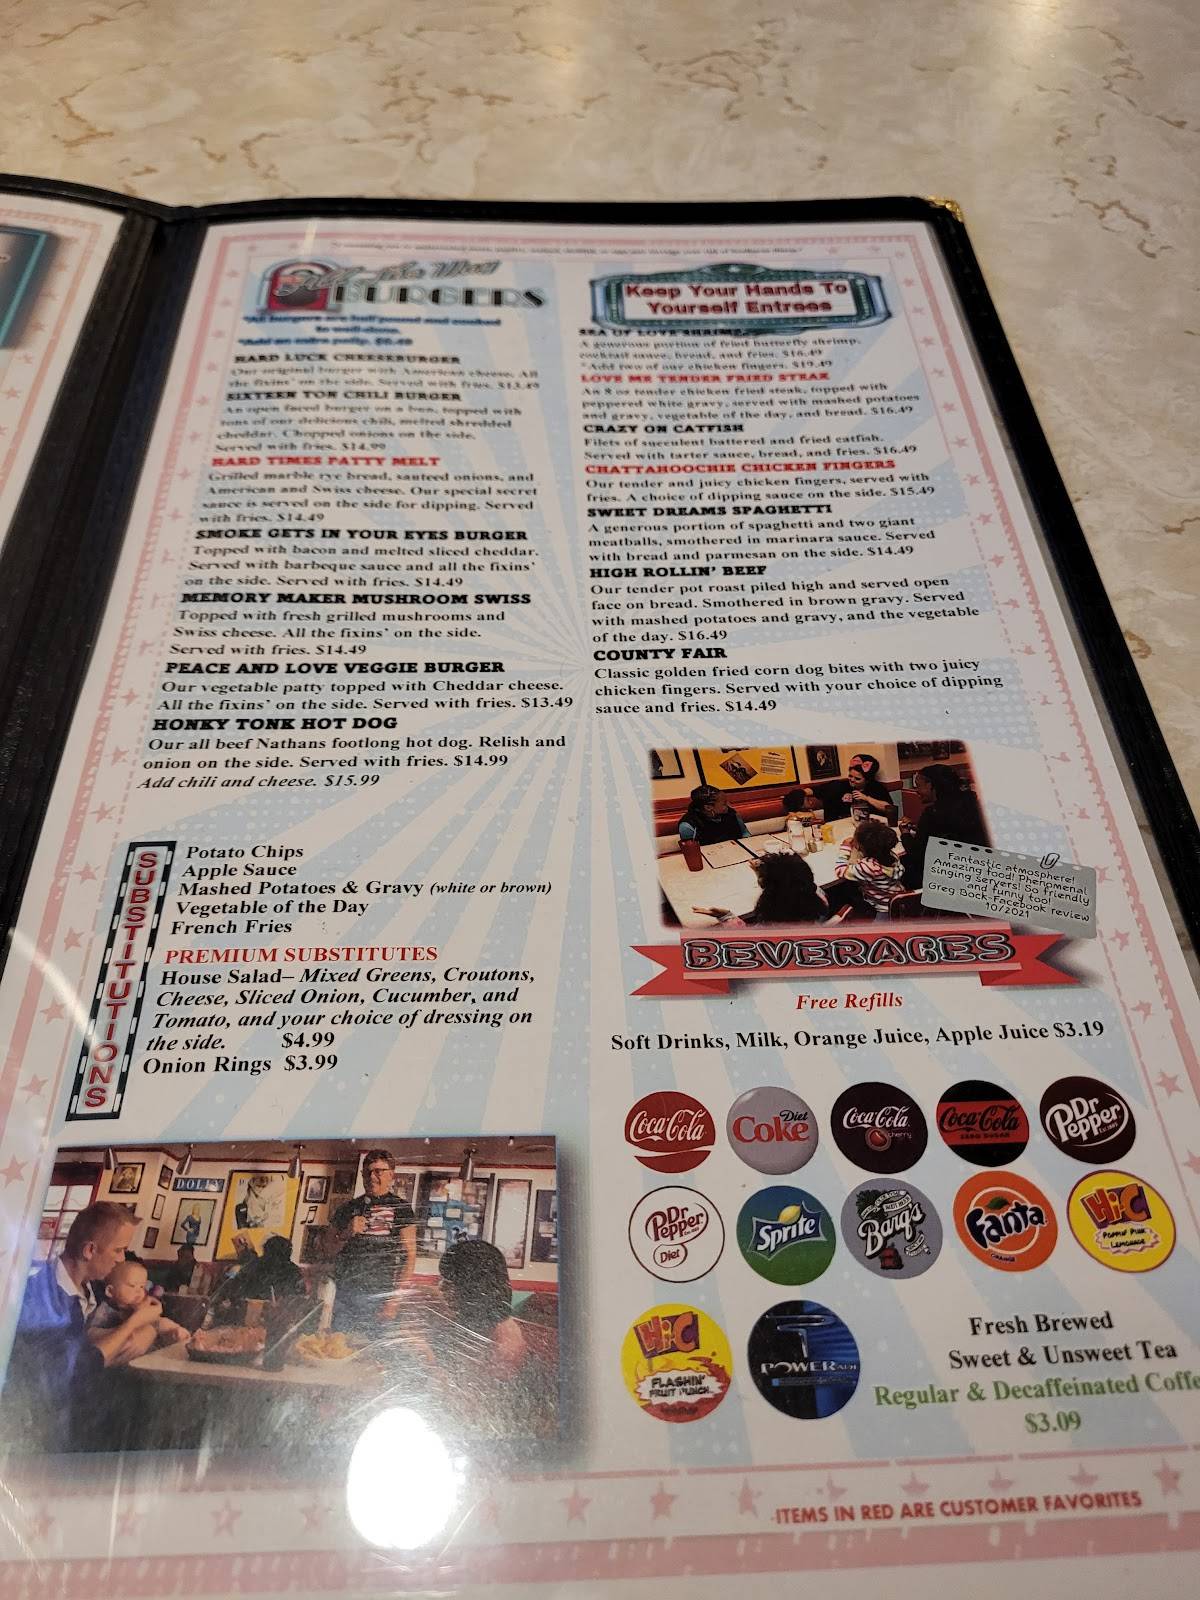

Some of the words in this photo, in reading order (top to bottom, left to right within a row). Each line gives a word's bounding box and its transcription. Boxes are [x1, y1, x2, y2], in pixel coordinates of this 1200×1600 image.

[626, 285, 680, 299] Keep
[689, 284, 738, 297] Your
[745, 282, 814, 296] Hands
[820, 282, 847, 294] To
[647, 301, 739, 315] Yourself
[745, 300, 832, 313] Entrees
[583, 424, 638, 433] CRAZY
[643, 425, 667, 433] ON
[672, 424, 744, 433] CATFISH
[584, 463, 736, 474] CHATTAHOOCHIE
[740, 462, 817, 472] CHICKEN
[822, 459, 896, 471] FINGERS
[587, 507, 647, 517] SWEET
[652, 506, 727, 517] DREAMS
[731, 504, 832, 515] SPAGHETTI
[195, 528, 262, 540] SMOKE
[267, 528, 315, 539] GETS
[321, 528, 341, 538] IN
[346, 529, 398, 540] YOUR
[403, 530, 448, 540] EYES
[454, 530, 528, 540] BURGER
[589, 567, 637, 578] HIGH
[642, 566, 716, 577] ROLLIN'
[721, 565, 767, 576] BEEF
[180, 592, 271, 603] MEMORY
[276, 592, 346, 604] MAKER
[351, 593, 468, 605] MUSHROOM
[473, 593, 531, 604] SWISS
[593, 648, 676, 661] COUNTY
[680, 647, 727, 659] FAIR
[164, 662, 231, 674] PEACE
[234, 663, 279, 674] AND
[284, 662, 338, 674] LOVE
[343, 662, 418, 674] VEGGIE
[423, 661, 505, 673] BURGER
[595, 705, 640, 714] sauce
[644, 701, 674, 713] and
[680, 701, 720, 712] fries.
[725, 699, 777, 712] $14.49
[152, 718, 230, 731] HONKY
[235, 718, 295, 730] TONK
[300, 717, 347, 730] HOT
[351, 716, 398, 729] DOG
[136, 776, 176, 788] Add
[177, 776, 218, 788] chili
[220, 775, 256, 787] and
[257, 775, 317, 787] cheese.
[323, 774, 380, 787] $15.99
[185, 846, 245, 859] Potato
[251, 845, 303, 861] Chips
[181, 863, 238, 880] Apple
[242, 863, 297, 876] Sauce
[933, 858, 982, 875] Amazing
[987, 867, 1014, 880] food!
[1019, 874, 1087, 895] Phenomenal
[948, 852, 1001, 869] Fantastic
[1005, 864, 1075, 884] atmosphere!
[178, 881, 252, 896] Mashed
[257, 881, 336, 895] Potatoes
[341, 880, 358, 894] &
[365, 880, 424, 897] Gravy
[429, 882, 476, 895] (white
[479, 884, 496, 893] or
[500, 881, 551, 895] brown)
[930, 866, 971, 882] singing
[976, 876, 1020, 890] servers!
[1025, 885, 1038, 894] So
[1044, 887, 1089, 907] friendly
[967, 883, 988, 892] and
[992, 887, 1024, 902] funny
[176, 900, 268, 918] Vegetable
[273, 899, 295, 913] of
[298, 899, 327, 913] the
[332, 899, 369, 916] Day
[928, 882, 955, 896] Greg
[1051, 908, 1090, 921] review
[985, 902, 1030, 918] 10/2021
[171, 920, 237, 935] French
[244, 919, 292, 933] Fries
[164, 948, 279, 964] PREMIUM
[283, 946, 438, 962] SUBSTITUTES
[683, 934, 1015, 970] BEVERAGES
[83, 851, 158, 1109] SUBSTITUTIONS
[159, 970, 222, 985] House
[298, 967, 361, 983] Mixed
[366, 967, 436, 984] Greens,
[443, 967, 534, 983] Croutons,
[156, 991, 228, 1007] Cheese,
[234, 989, 296, 1004] Sliced
[300, 988, 365, 1005] Onion,
[372, 987, 476, 1005] Cucumber,
[482, 986, 519, 1002] and
[796, 995, 838, 1010] Free
[844, 992, 903, 1012] Refills
[152, 1013, 231, 1029] Tomato,
[237, 1010, 277, 1026] and
[276, 1014, 326, 1030] your
[330, 1009, 393, 1025] choice
[398, 1009, 422, 1029] of
[423, 1008, 504, 1027] dressing
[508, 1012, 532, 1024] on
[145, 1035, 178, 1051] the
[181, 1033, 225, 1050] side.
[281, 1031, 335, 1048] $4.99
[611, 1034, 650, 1050] Soft
[657, 1033, 730, 1051] Drinks,
[735, 1031, 788, 1049] Milk,
[793, 1030, 867, 1049] Orange
[873, 1028, 930, 1045] Juice,
[935, 1025, 993, 1046] Apple
[998, 1023, 1049, 1040] Juice
[1052, 1020, 1104, 1038] $3.19
[142, 1057, 205, 1074] Onion
[213, 1056, 271, 1076] Rings
[283, 1054, 338, 1072] $3.99
[779, 1109, 808, 1122] Diet
[1071, 1097, 1099, 1118] Dr
[732, 1115, 810, 1143] Coke
[1053, 1102, 1122, 1143] Pepper
[667, 1206, 688, 1223] Dr
[652, 1211, 704, 1242] Pepper
[757, 1217, 817, 1252] Sprite
[857, 1203, 924, 1257] Barq's
[965, 1201, 1046, 1249] Fanta
[660, 1250, 681, 1264] Diet
[969, 1315, 1029, 1336] Fresh
[1034, 1310, 1114, 1332] Brewed
[948, 1349, 1011, 1369] Sweet
[1017, 1346, 1037, 1366] &
[1042, 1343, 1132, 1364] Unsweet
[1135, 1340, 1177, 1359] Tea
[874, 1383, 960, 1410] Regular
[966, 1381, 986, 1402] &
[992, 1373, 1140, 1400] Decaffeinated
[1024, 1410, 1081, 1434] $3.09
[775, 1505, 829, 1524] ITEMS
[833, 1505, 855, 1522] IN
[860, 1503, 894, 1520] RED
[900, 1501, 935, 1520] ARE
[939, 1496, 1039, 1517] CUSTOMER
[1042, 1490, 1142, 1511] FAVORITES
